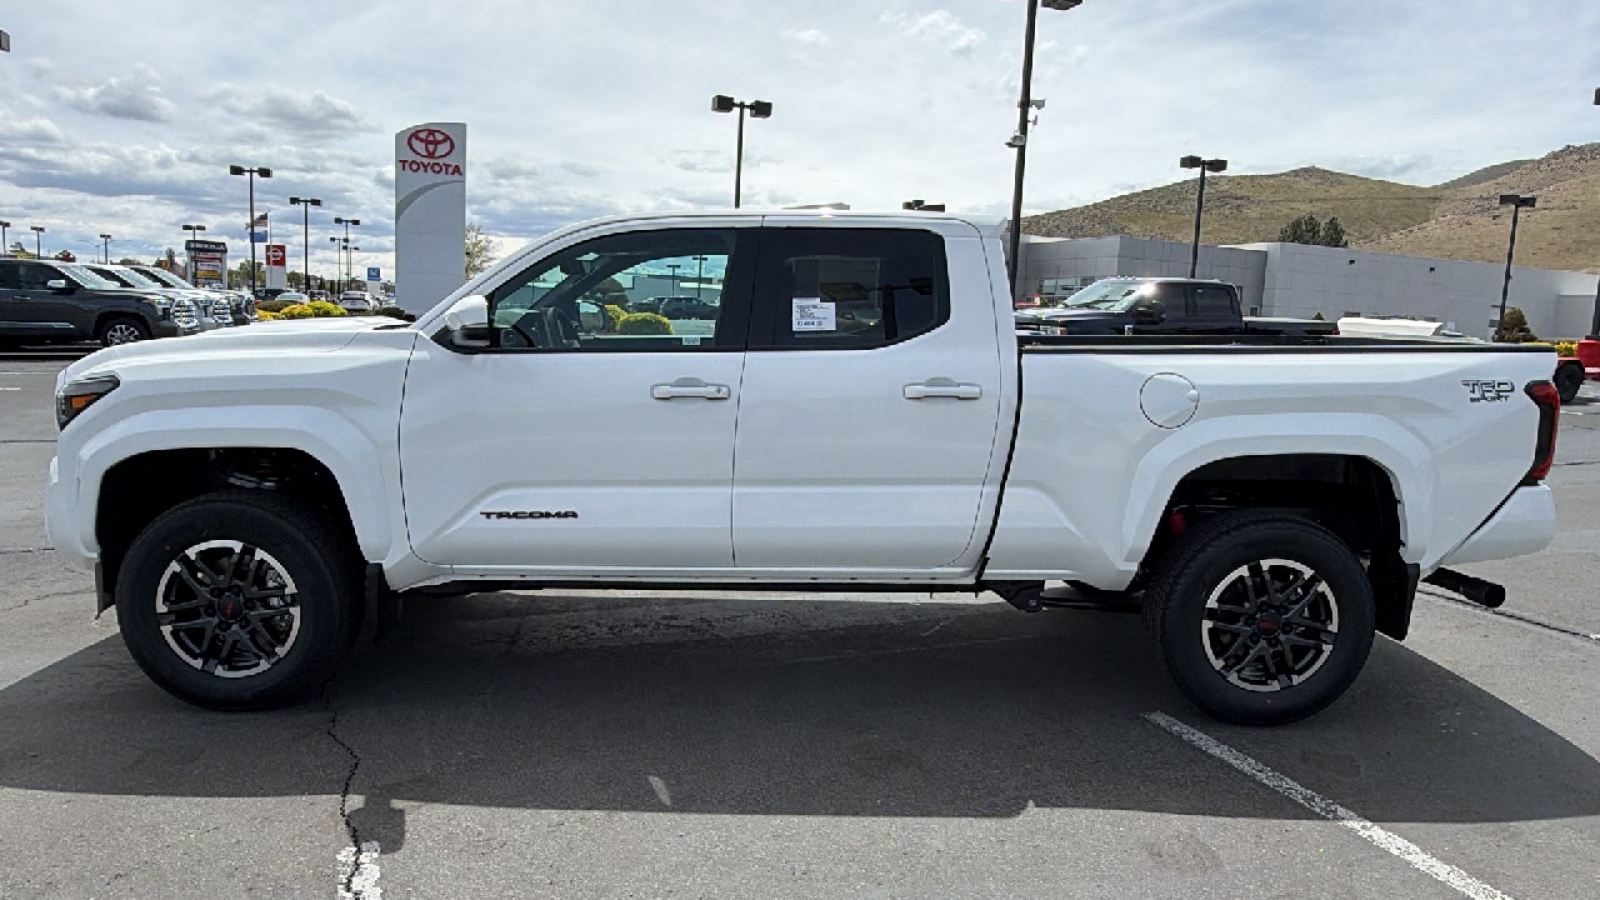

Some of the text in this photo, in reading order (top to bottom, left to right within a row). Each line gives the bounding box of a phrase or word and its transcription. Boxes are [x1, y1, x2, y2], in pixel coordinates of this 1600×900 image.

[399, 159, 463, 176] TOYOTA
[1461, 379, 1515, 397] TRD
[480, 510, 579, 520] TACOMA
